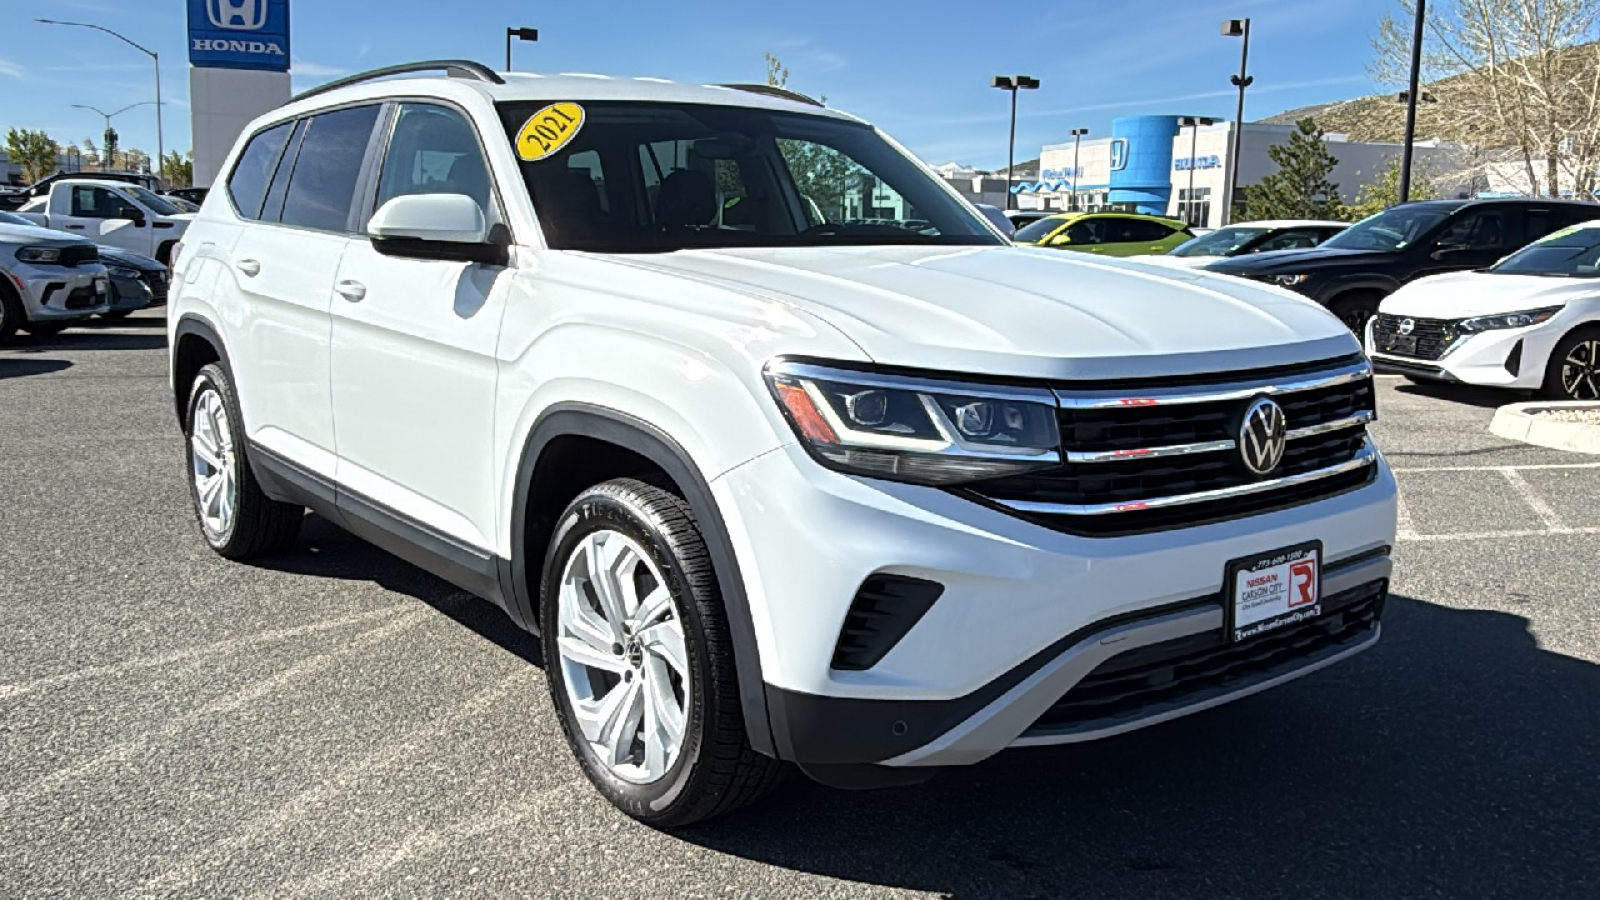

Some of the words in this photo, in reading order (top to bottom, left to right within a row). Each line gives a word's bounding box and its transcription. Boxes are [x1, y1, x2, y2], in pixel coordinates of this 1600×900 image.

[193, 39, 285, 55] HONDA
[526, 107, 575, 152] 2021
[1246, 574, 1278, 588] NISSAN
[1242, 587, 1268, 601] CARSON
